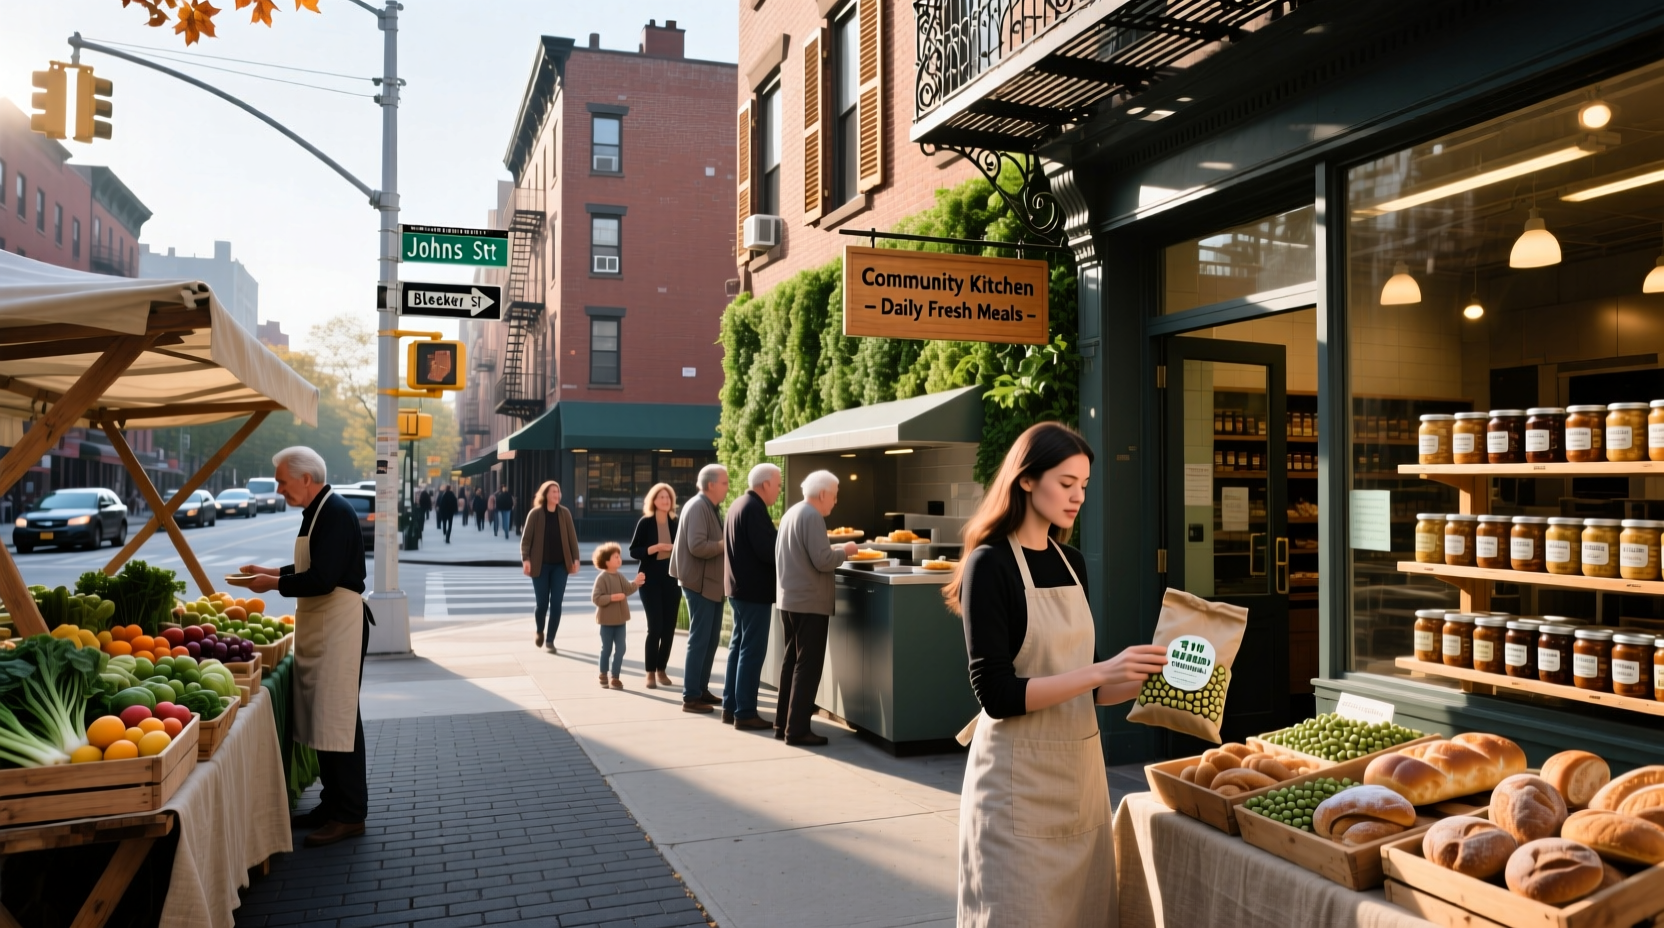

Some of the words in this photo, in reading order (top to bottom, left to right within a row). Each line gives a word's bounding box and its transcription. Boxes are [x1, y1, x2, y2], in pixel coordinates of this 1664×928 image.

[407, 236, 463, 260] Johns
[862, 267, 964, 297] Community
[970, 274, 1034, 296] Kitchen
[881, 297, 923, 322] Daily
[928, 300, 972, 320] Fresh
[977, 302, 1023, 322] Meals
